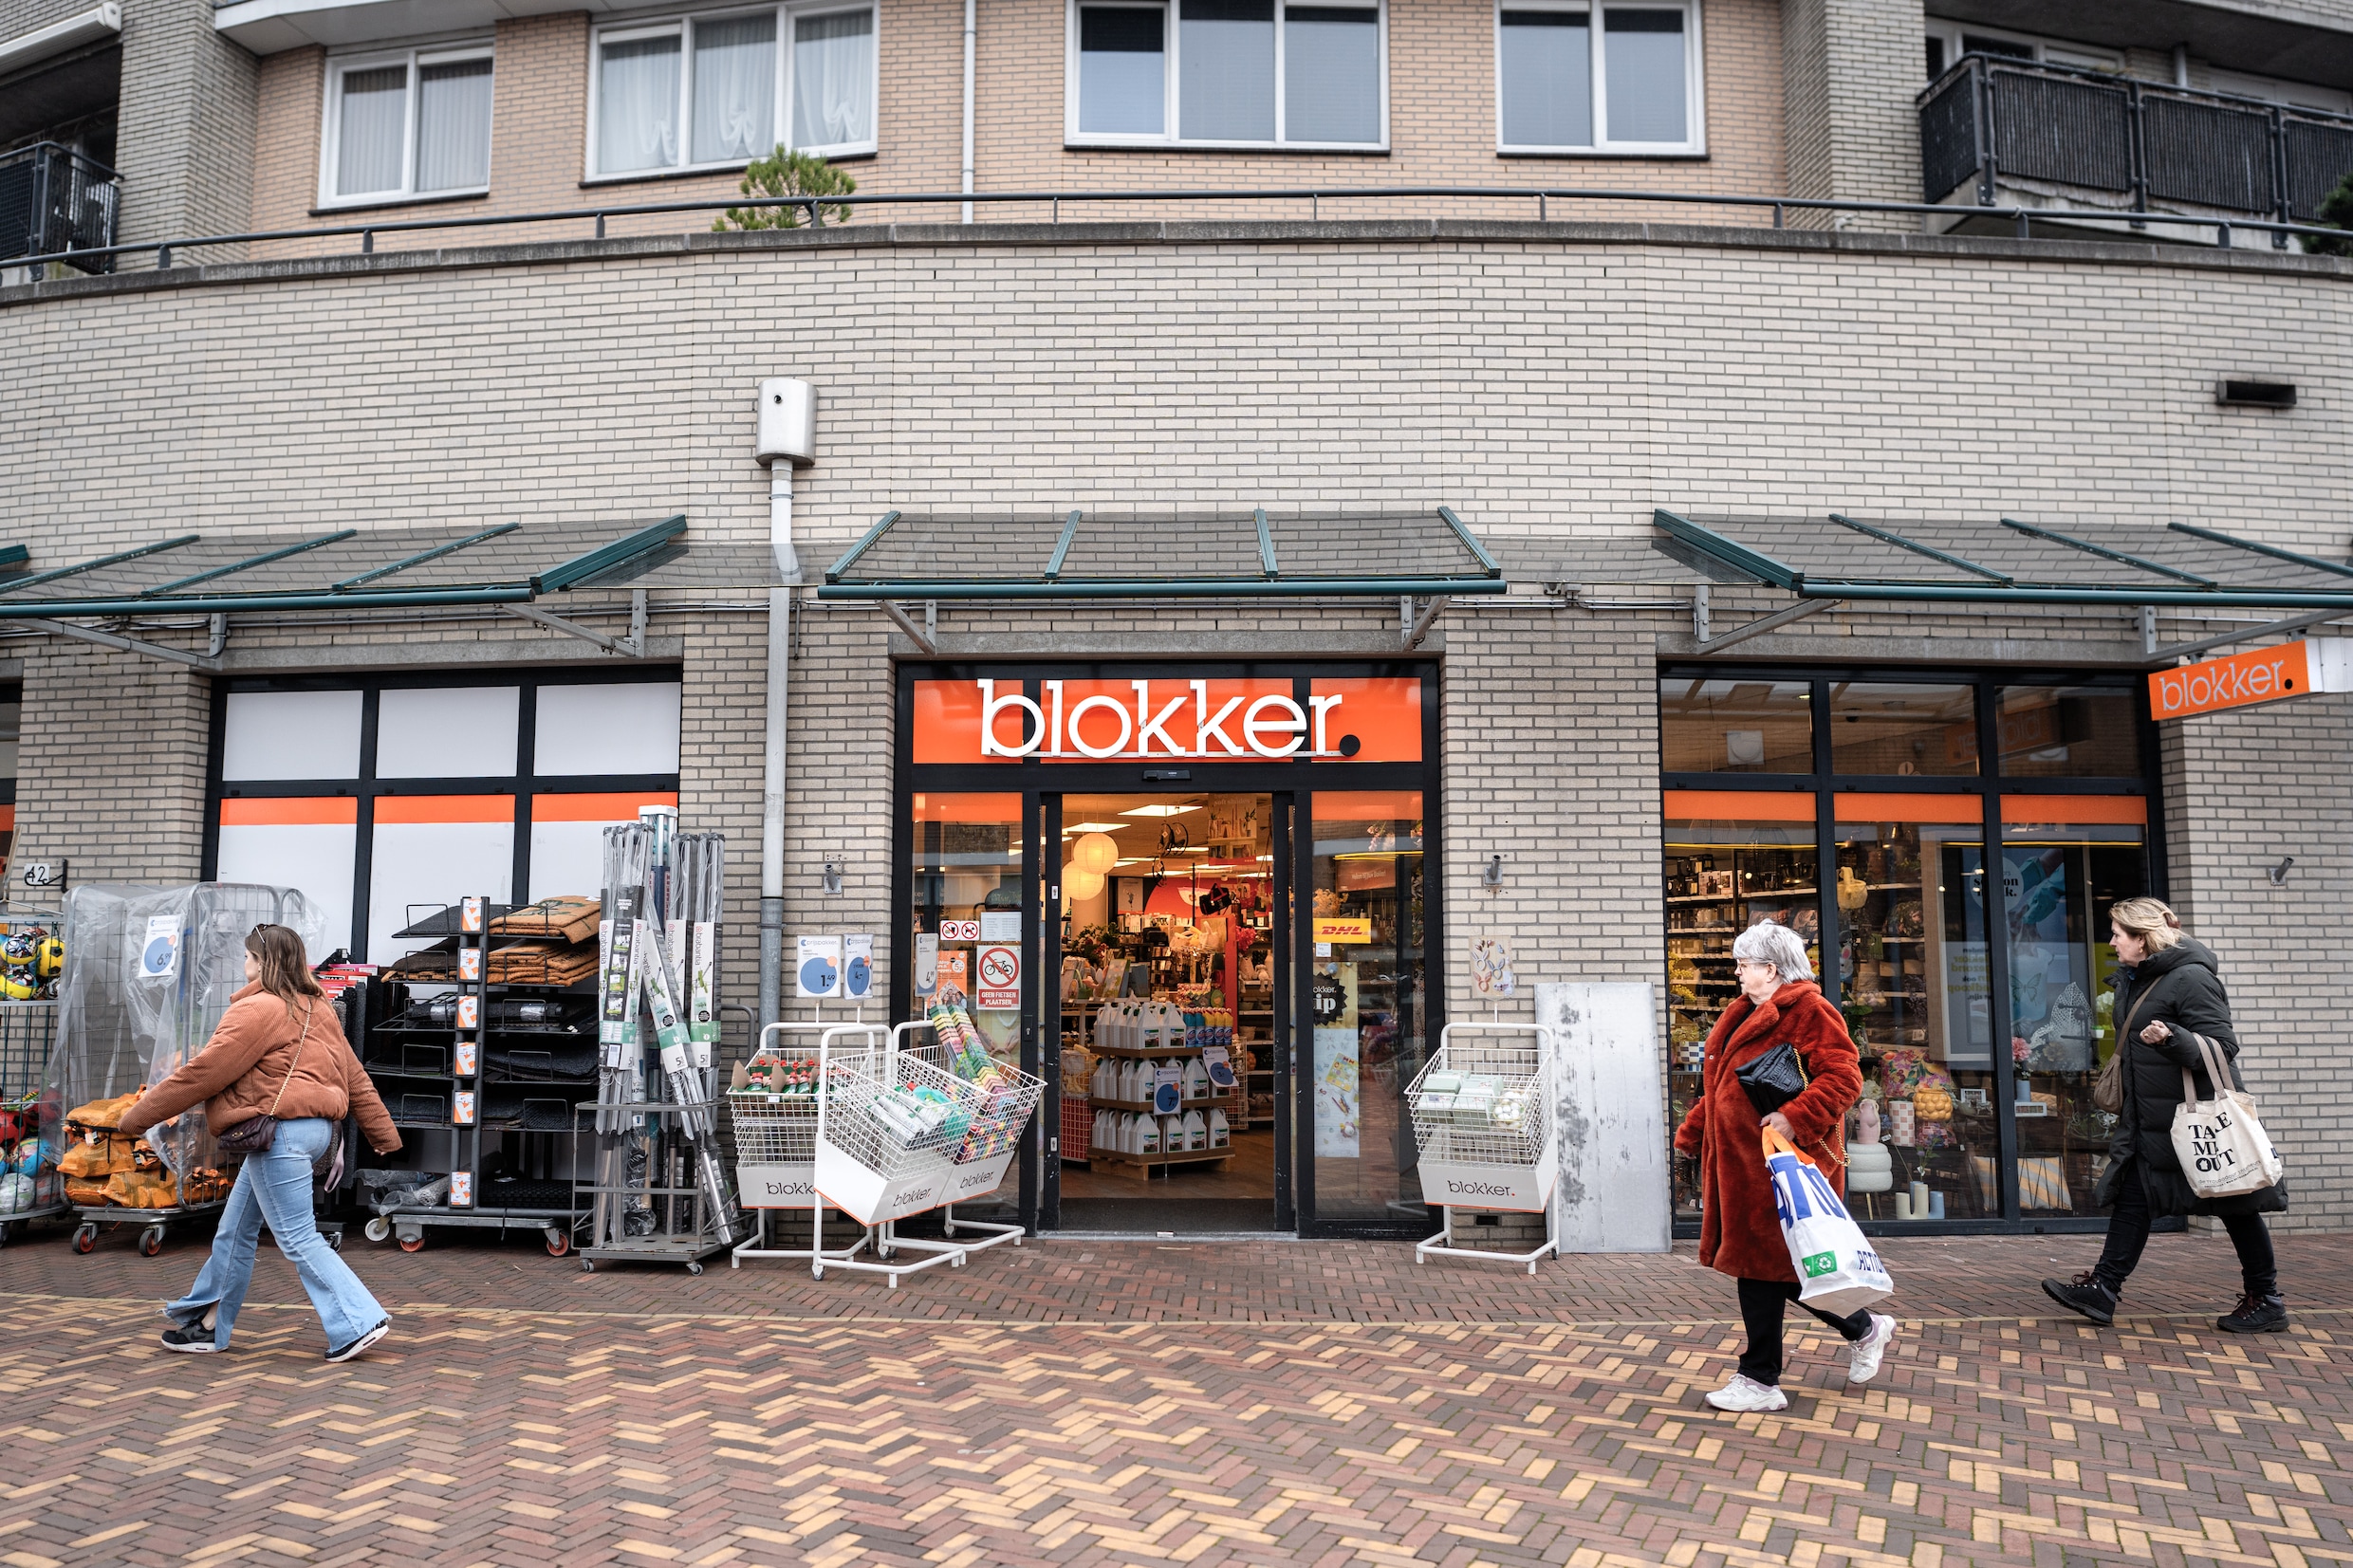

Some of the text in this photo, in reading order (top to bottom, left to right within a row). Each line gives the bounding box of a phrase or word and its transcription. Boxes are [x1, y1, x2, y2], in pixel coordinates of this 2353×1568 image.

[2159, 659, 2293, 711] blokker.
[977, 678, 1361, 758] blokker.
[26, 865, 46, 883] 42
[1321, 926, 1363, 935] DHL
[695, 932, 703, 966] brabantia
[820, 974, 836, 987] 1.49
[1313, 986, 1337, 994] okker.
[1313, 993, 1337, 1015] ip
[2188, 1112, 2233, 1139] TAE
[2196, 1149, 2235, 1172] OUT
[766, 1182, 815, 1195] blokk
[959, 1171, 994, 1190] blokker.
[1447, 1180, 1516, 1197] blokker.
[892, 1187, 932, 1208] blokker.
[1857, 1250, 1886, 1275] ACTIO
